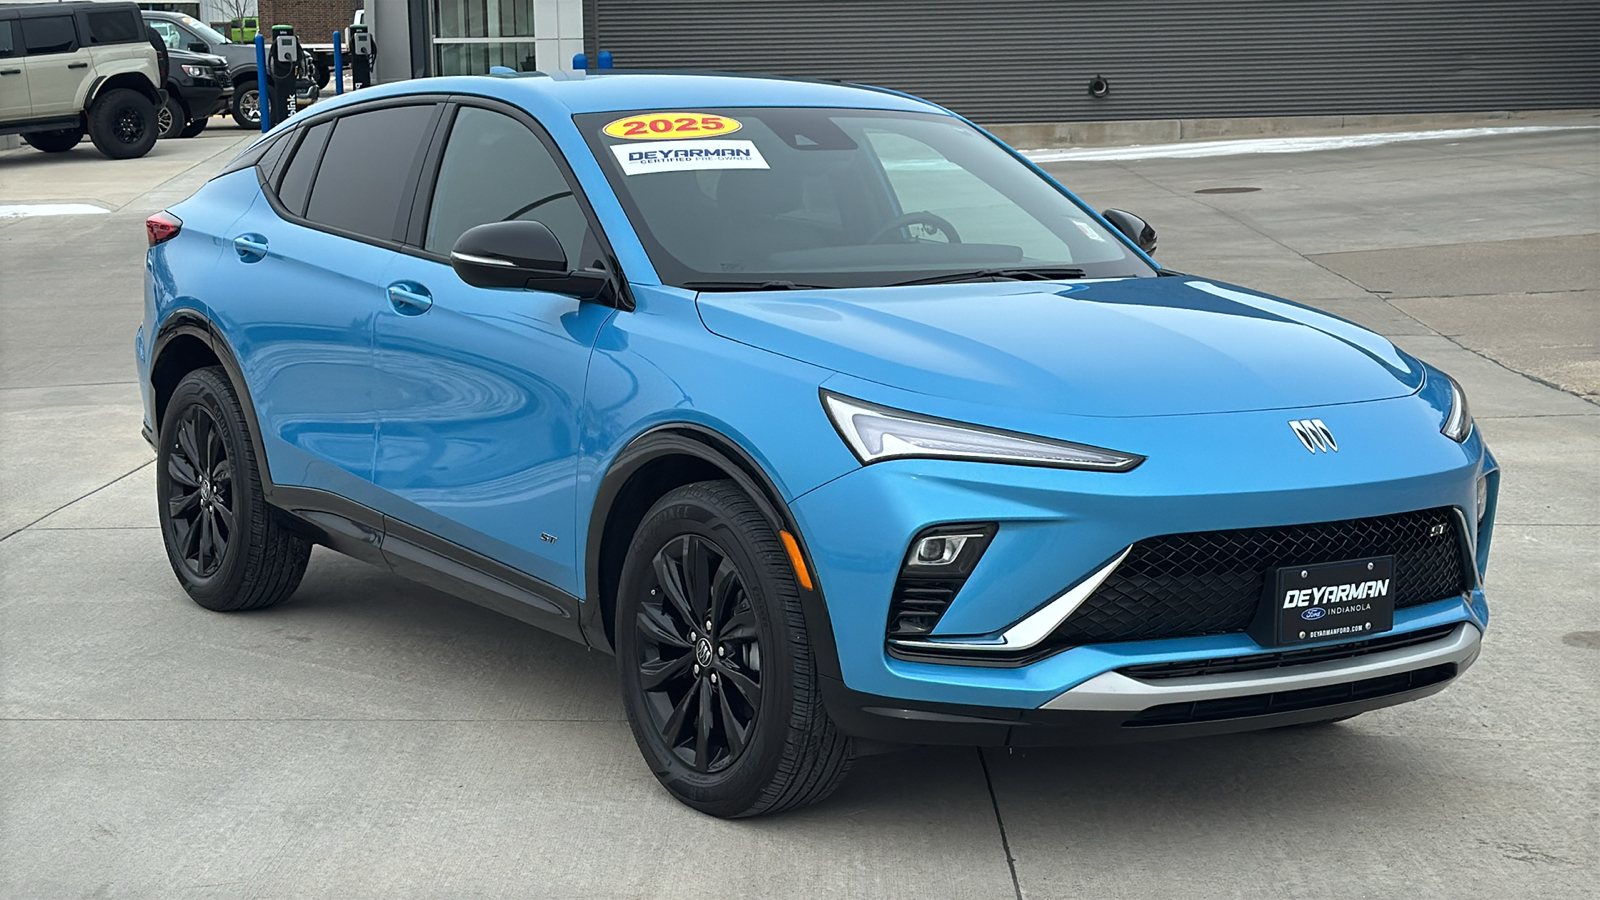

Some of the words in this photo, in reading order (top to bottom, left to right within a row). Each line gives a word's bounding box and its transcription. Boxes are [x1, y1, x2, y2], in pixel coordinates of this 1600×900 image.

[623, 117, 725, 136] 2025
[628, 148, 751, 161] DEYARMAN
[640, 156, 692, 165] CERTIFIED
[1430, 522, 1447, 537] ST
[540, 531, 558, 545] ST
[1283, 579, 1390, 609] DEYARMAN
[1327, 603, 1371, 615] INDIANOLA
[1310, 624, 1363, 638] DEYARMANFORD.COM
